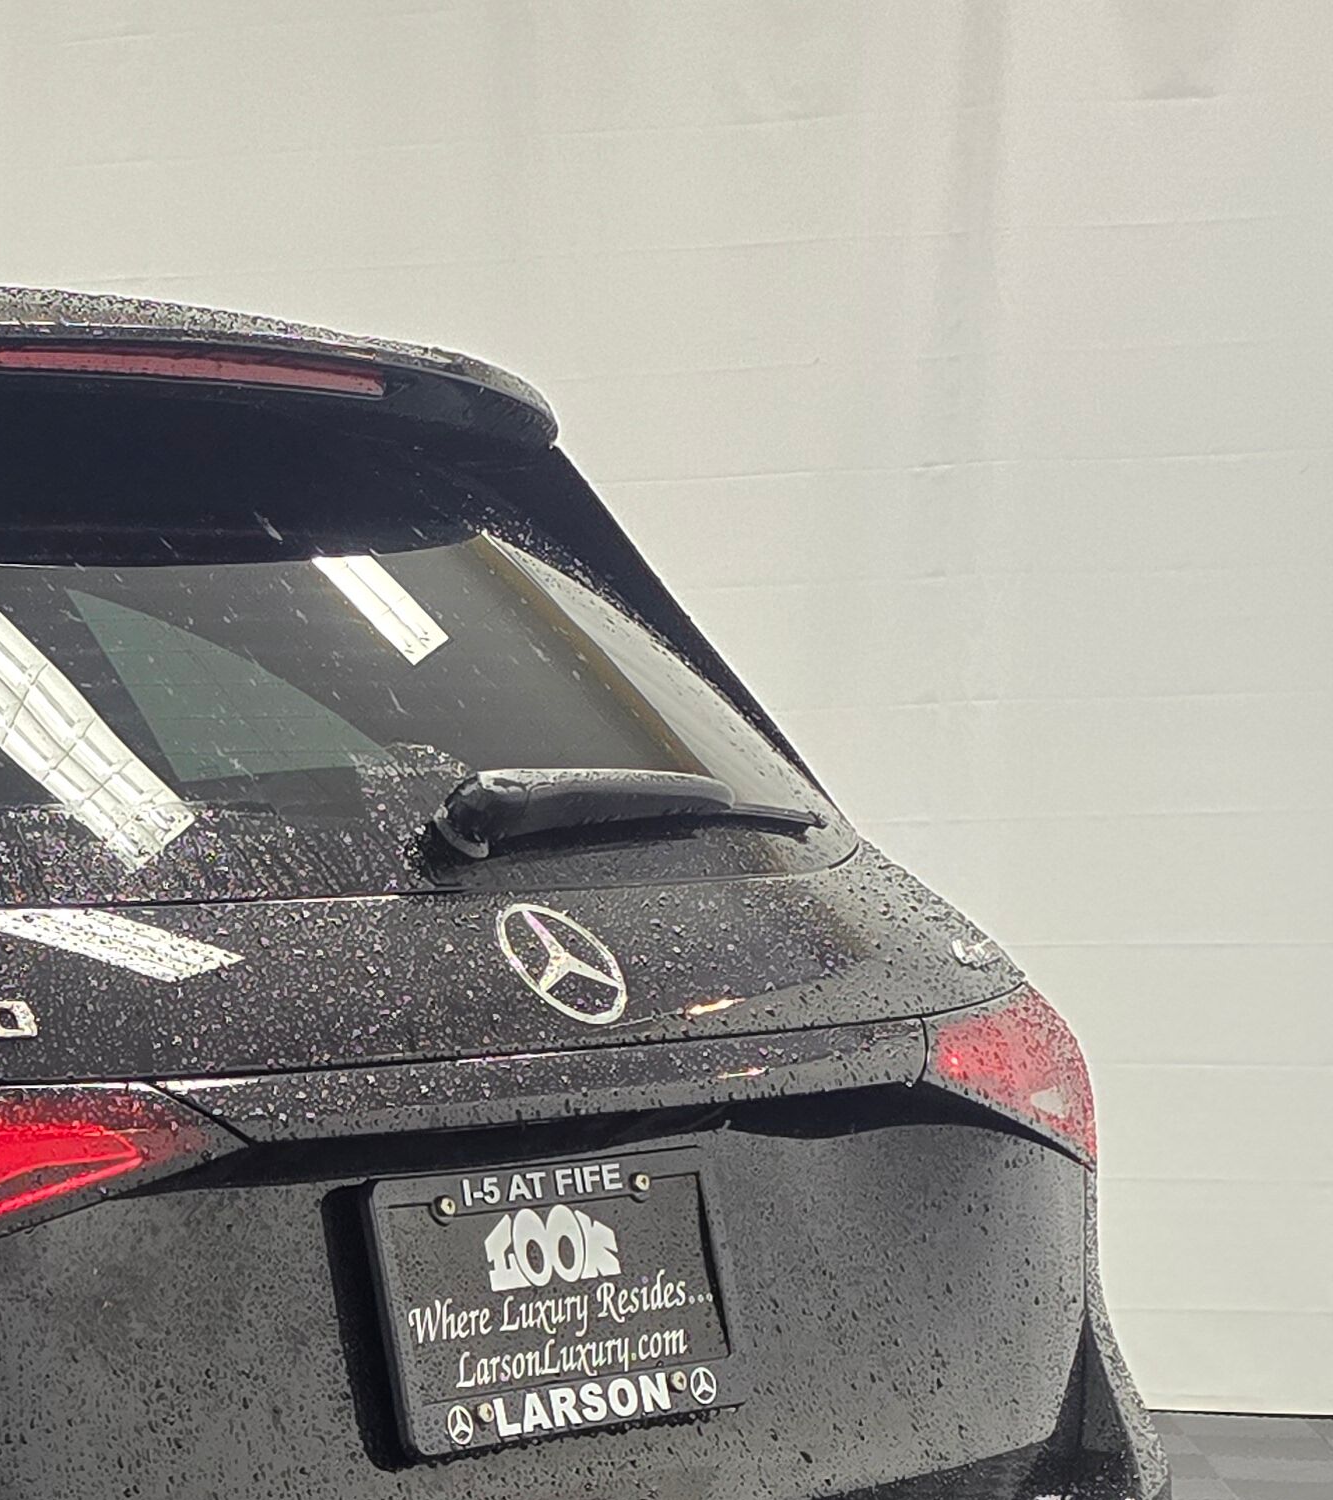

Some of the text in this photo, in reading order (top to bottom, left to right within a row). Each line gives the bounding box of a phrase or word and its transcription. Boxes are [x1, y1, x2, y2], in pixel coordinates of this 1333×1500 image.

[463, 1164, 623, 1206] I-5 AT FIFE
[484, 1204, 622, 1291] LOOK
[409, 1270, 713, 1344] Where Luxury Resides...
[456, 1328, 687, 1388] LarsonLuxury.com
[492, 1372, 672, 1437] LARSON
